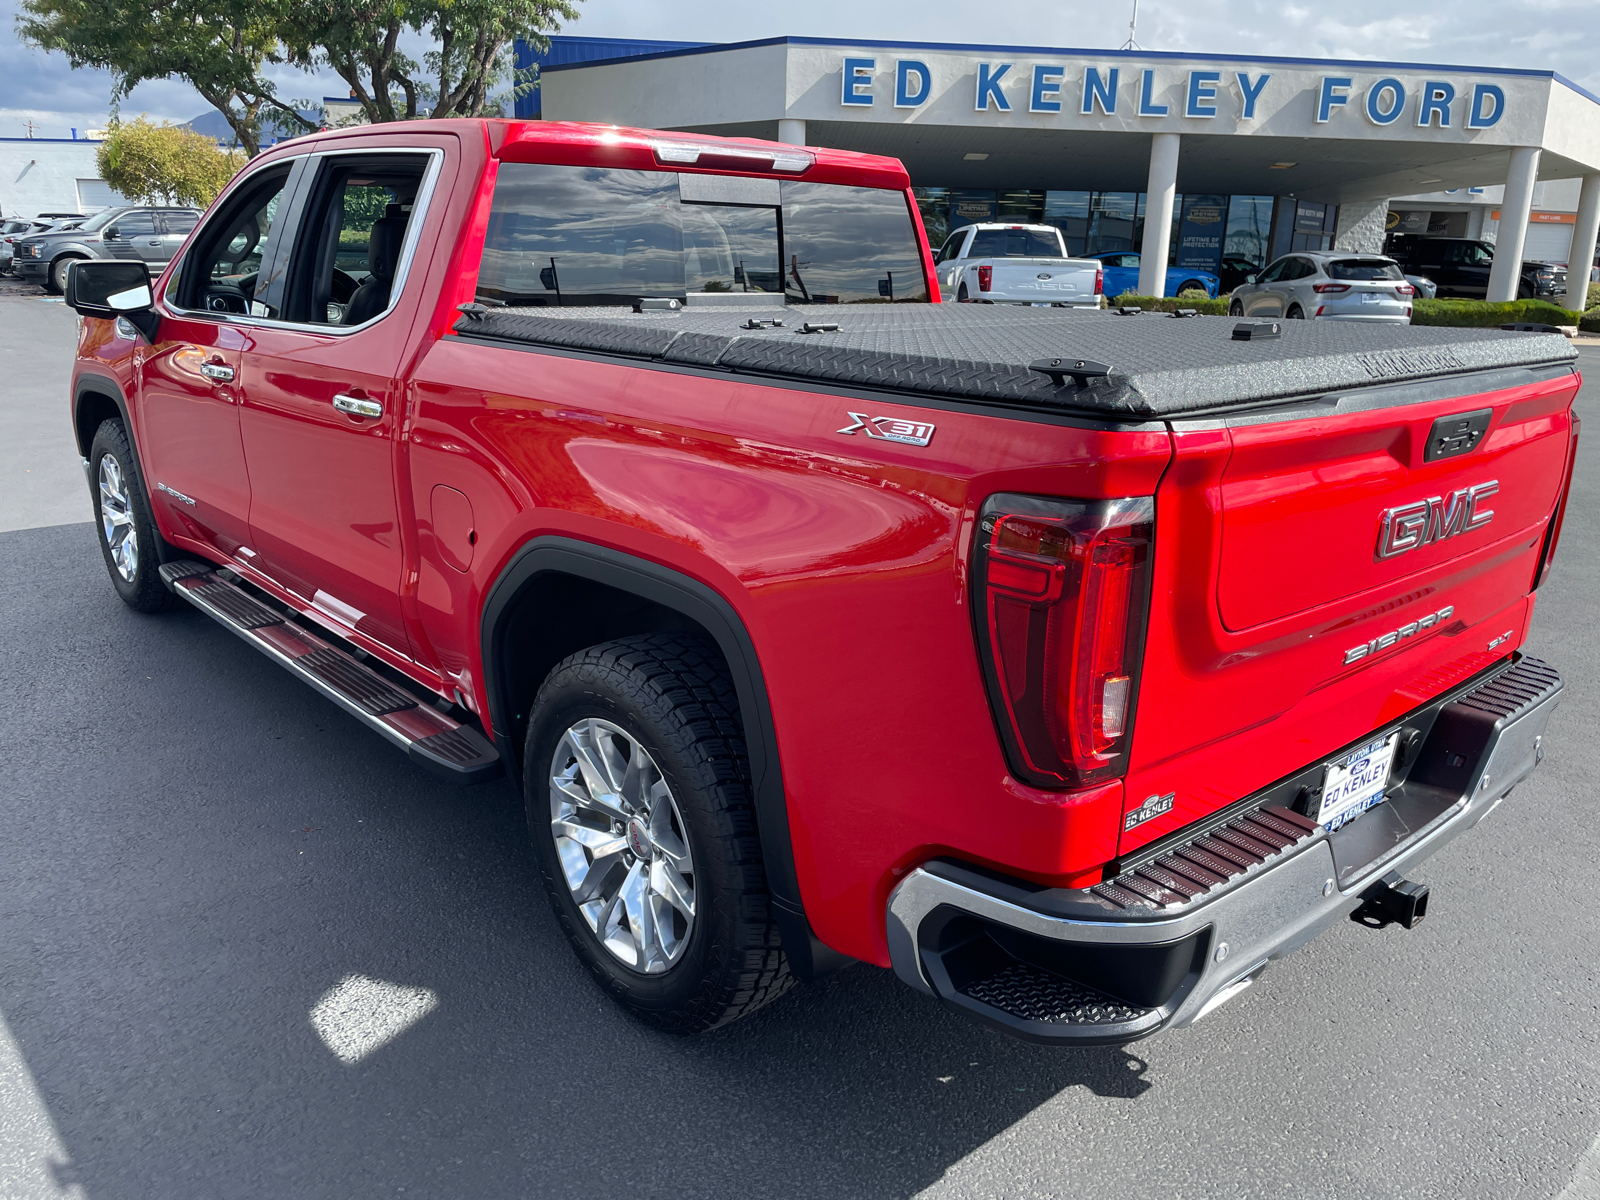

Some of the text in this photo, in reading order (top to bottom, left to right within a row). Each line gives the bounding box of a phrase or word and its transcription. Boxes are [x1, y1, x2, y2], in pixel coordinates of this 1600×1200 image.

[841, 57, 1506, 130] ED KENLEY FORD
[836, 411, 928, 440] X31
[902, 435, 921, 443] ROAD
[157, 481, 197, 507] SIERRA
[1379, 480, 1499, 558] GMC
[1342, 605, 1455, 666] SIERRA
[1487, 630, 1513, 651] SLT
[1324, 786, 1341, 809] ED
[1342, 760, 1388, 798] KENLEY
[1125, 813, 1138, 828] ED
[1139, 797, 1174, 821] KENLEY
[1331, 815, 1343, 829] ED
[1342, 797, 1374, 823] KENLEY
[631, 822, 643, 855] GMC
